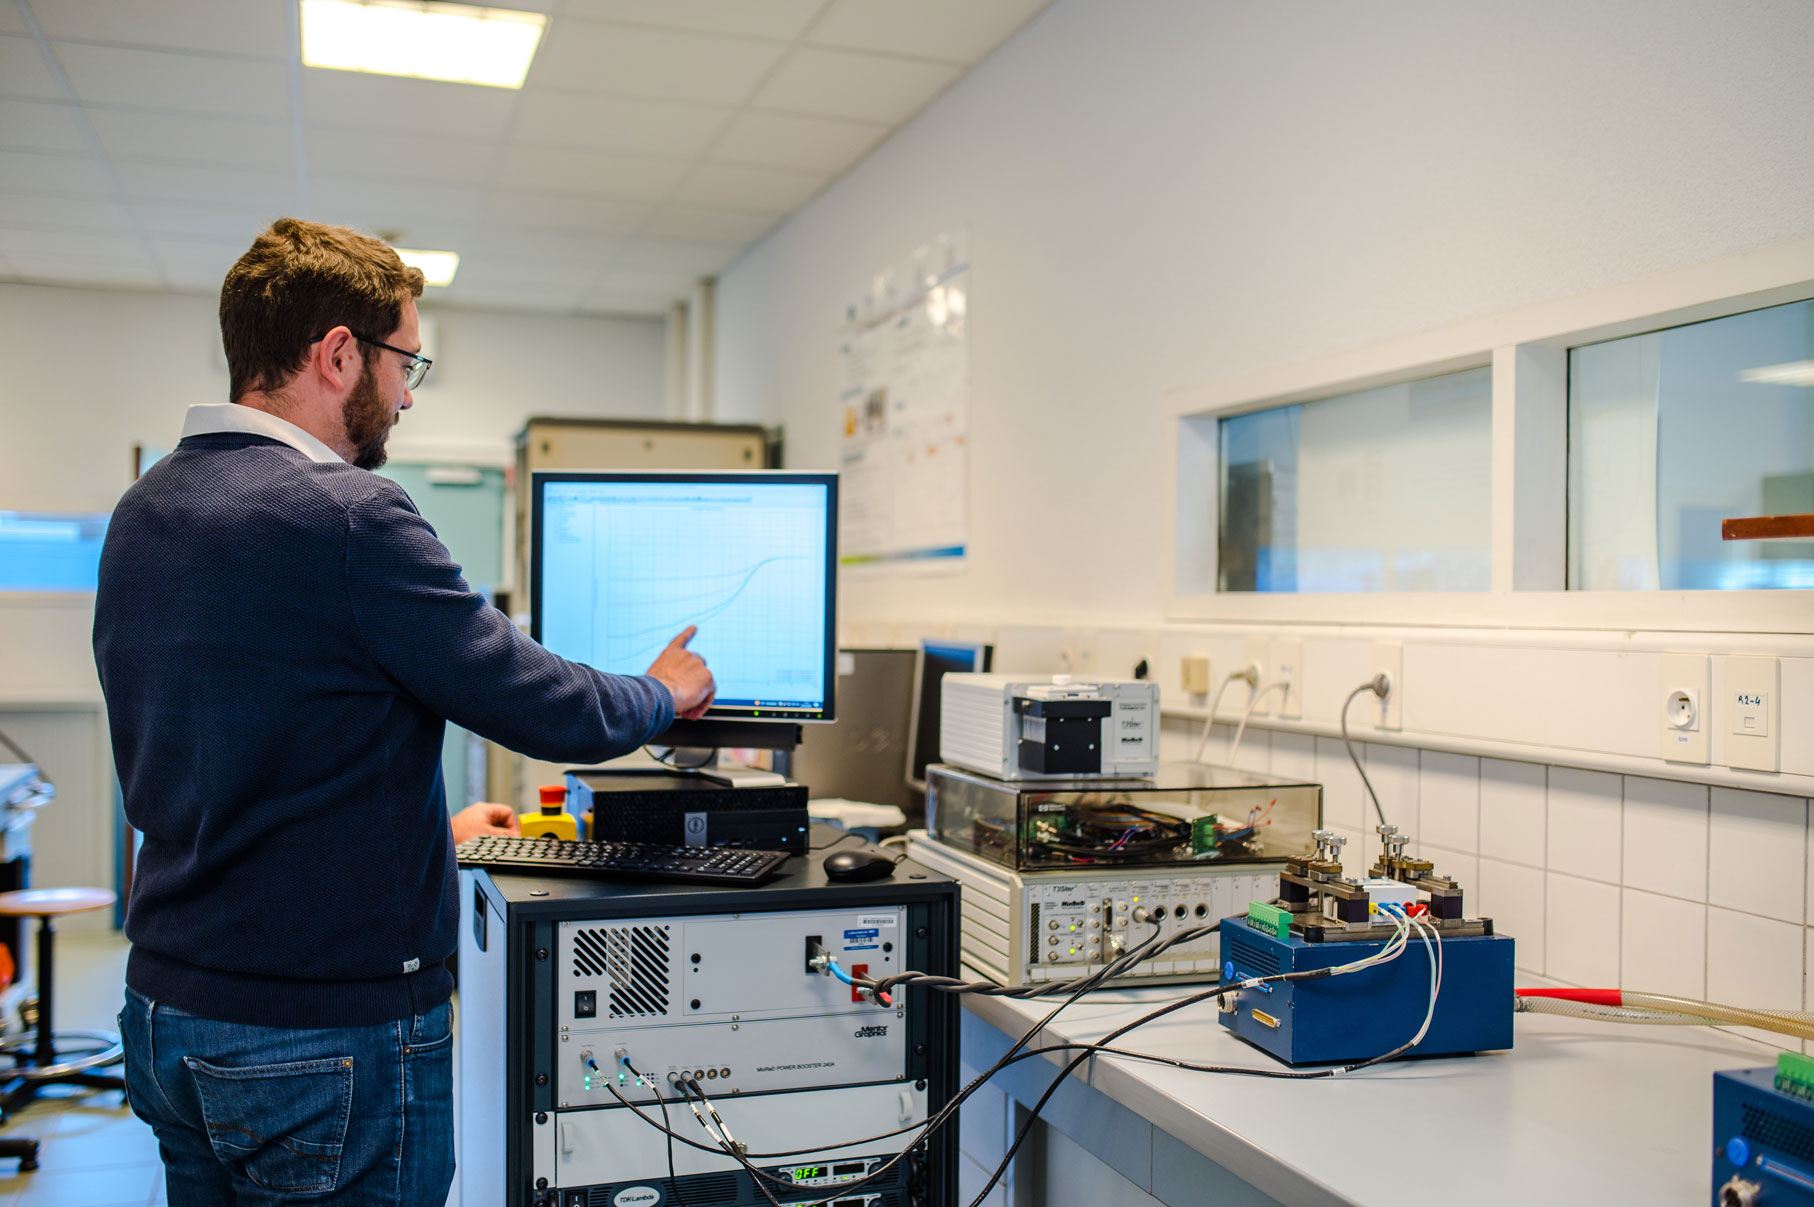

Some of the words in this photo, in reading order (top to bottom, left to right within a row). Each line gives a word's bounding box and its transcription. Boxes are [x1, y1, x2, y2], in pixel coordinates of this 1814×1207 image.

[861, 1025, 888, 1033] Mentor
[854, 1030, 887, 1038] Graphics
[797, 1062, 822, 1070] BOOSTER
[795, 1167, 820, 1180] OFF
